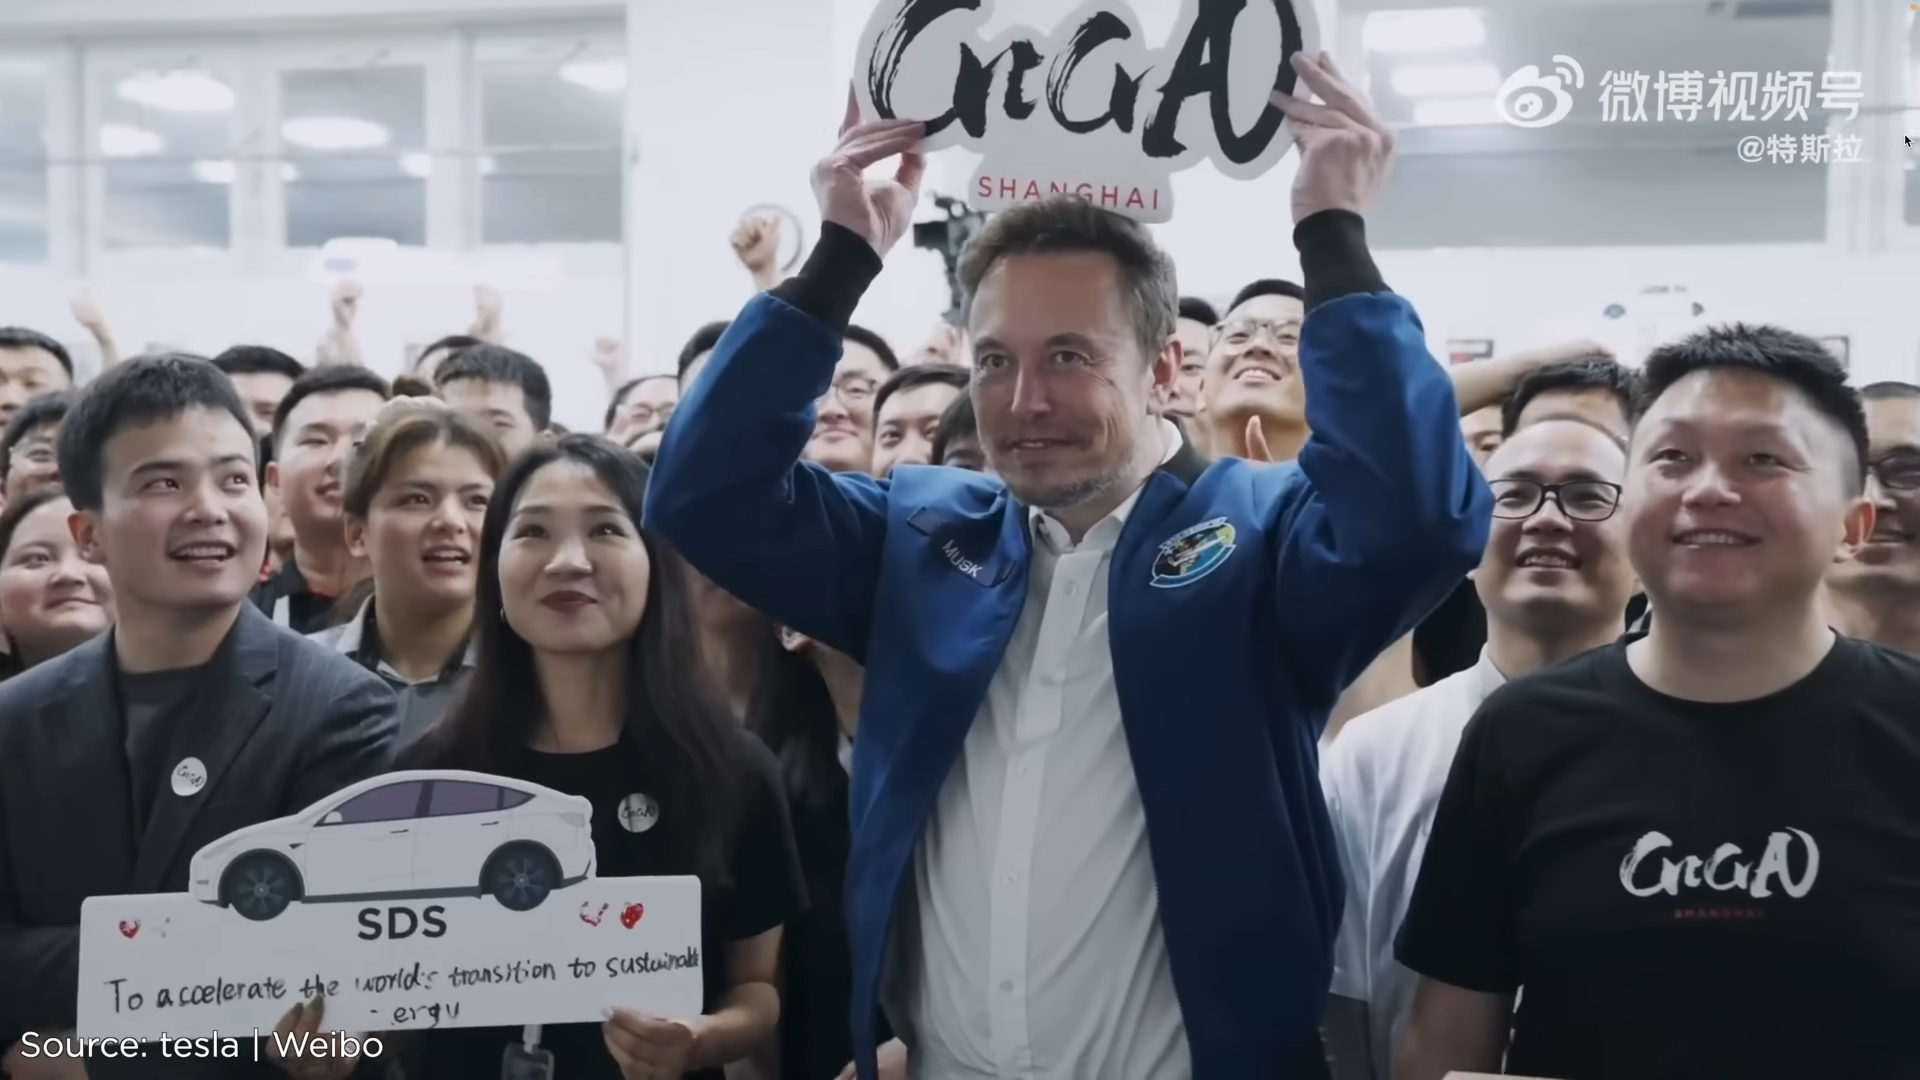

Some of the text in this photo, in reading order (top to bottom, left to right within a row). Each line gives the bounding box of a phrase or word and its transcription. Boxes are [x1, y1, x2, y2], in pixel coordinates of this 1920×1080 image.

[978, 176, 1158, 210] SHANGHAI
[942, 539, 984, 578] MUSK
[357, 905, 448, 940] SDS
[104, 979, 143, 1013] To
[299, 974, 339, 1000] the
[448, 959, 556, 988] transition
[568, 957, 596, 979] to
